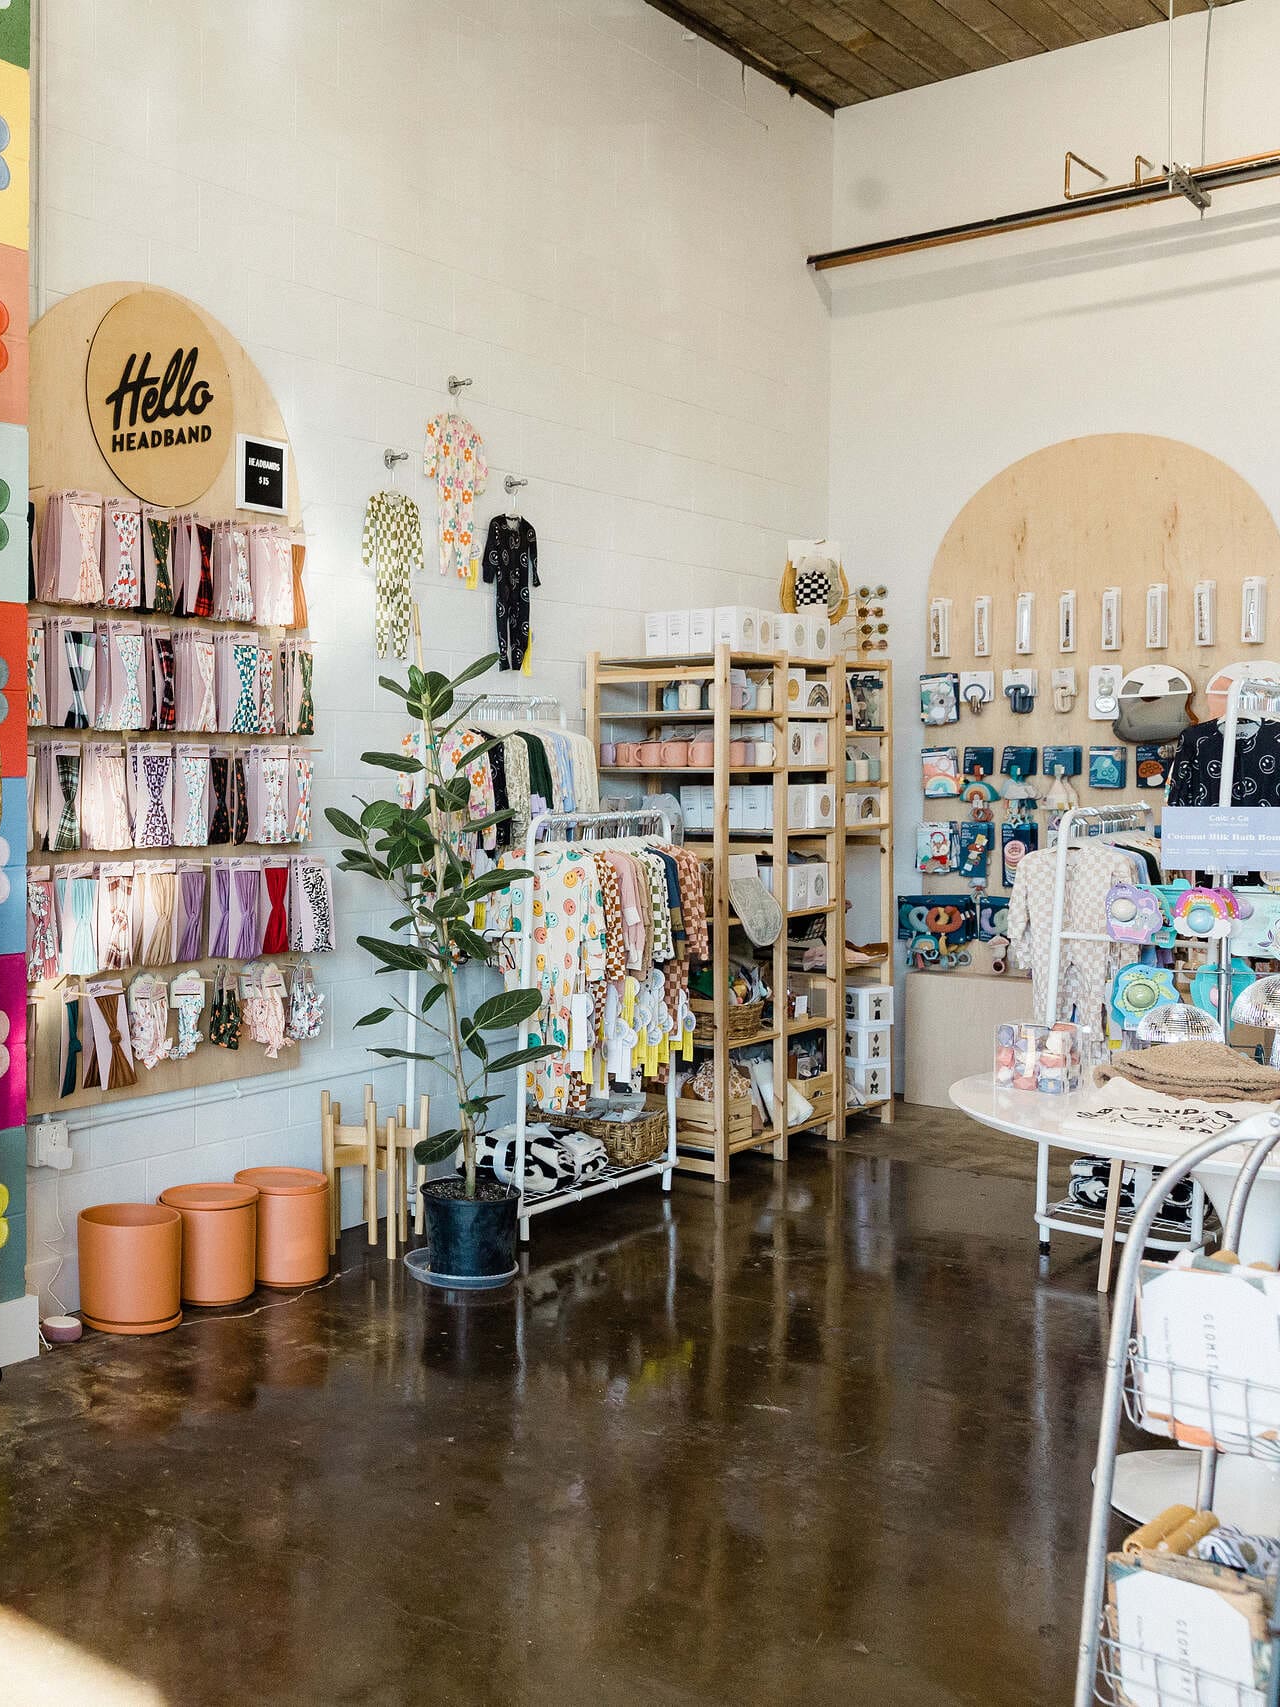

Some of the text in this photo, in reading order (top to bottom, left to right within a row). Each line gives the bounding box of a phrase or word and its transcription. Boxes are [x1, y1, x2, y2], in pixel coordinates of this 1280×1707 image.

[105, 347, 214, 431] Hello
[111, 425, 212, 453] HEADBAND
[248, 456, 281, 472] HEADBANDS
